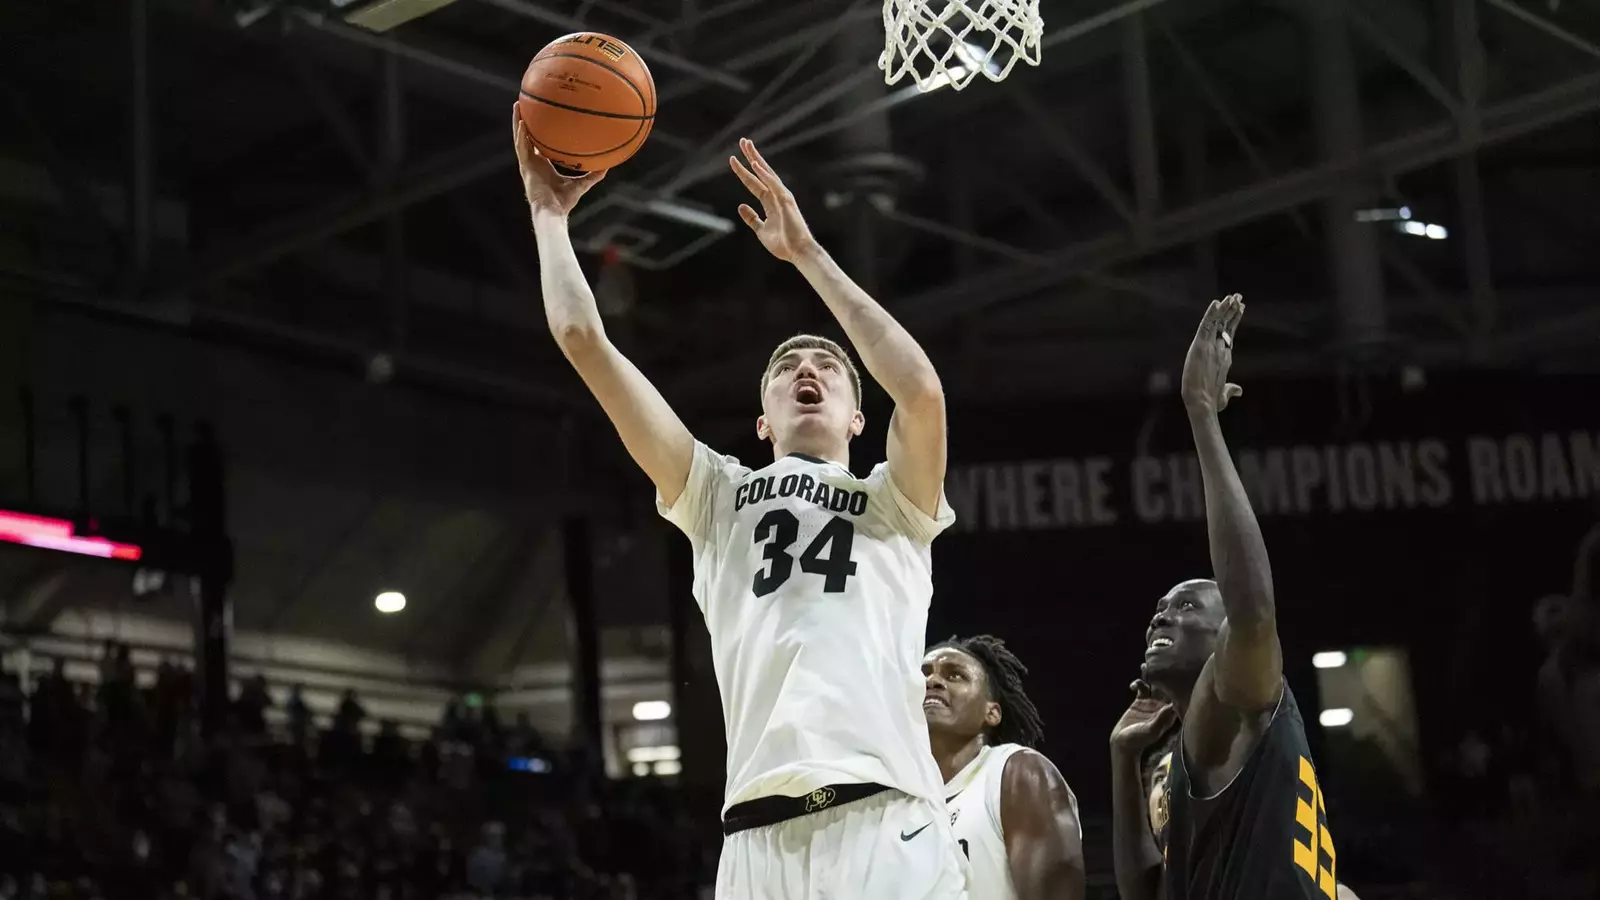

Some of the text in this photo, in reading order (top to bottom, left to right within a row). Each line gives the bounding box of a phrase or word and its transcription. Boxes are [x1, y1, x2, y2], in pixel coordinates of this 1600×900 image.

[735, 473, 868, 516] COLORADO
[1131, 439, 1452, 522] CHMPIONS
[752, 508, 858, 598] 34
